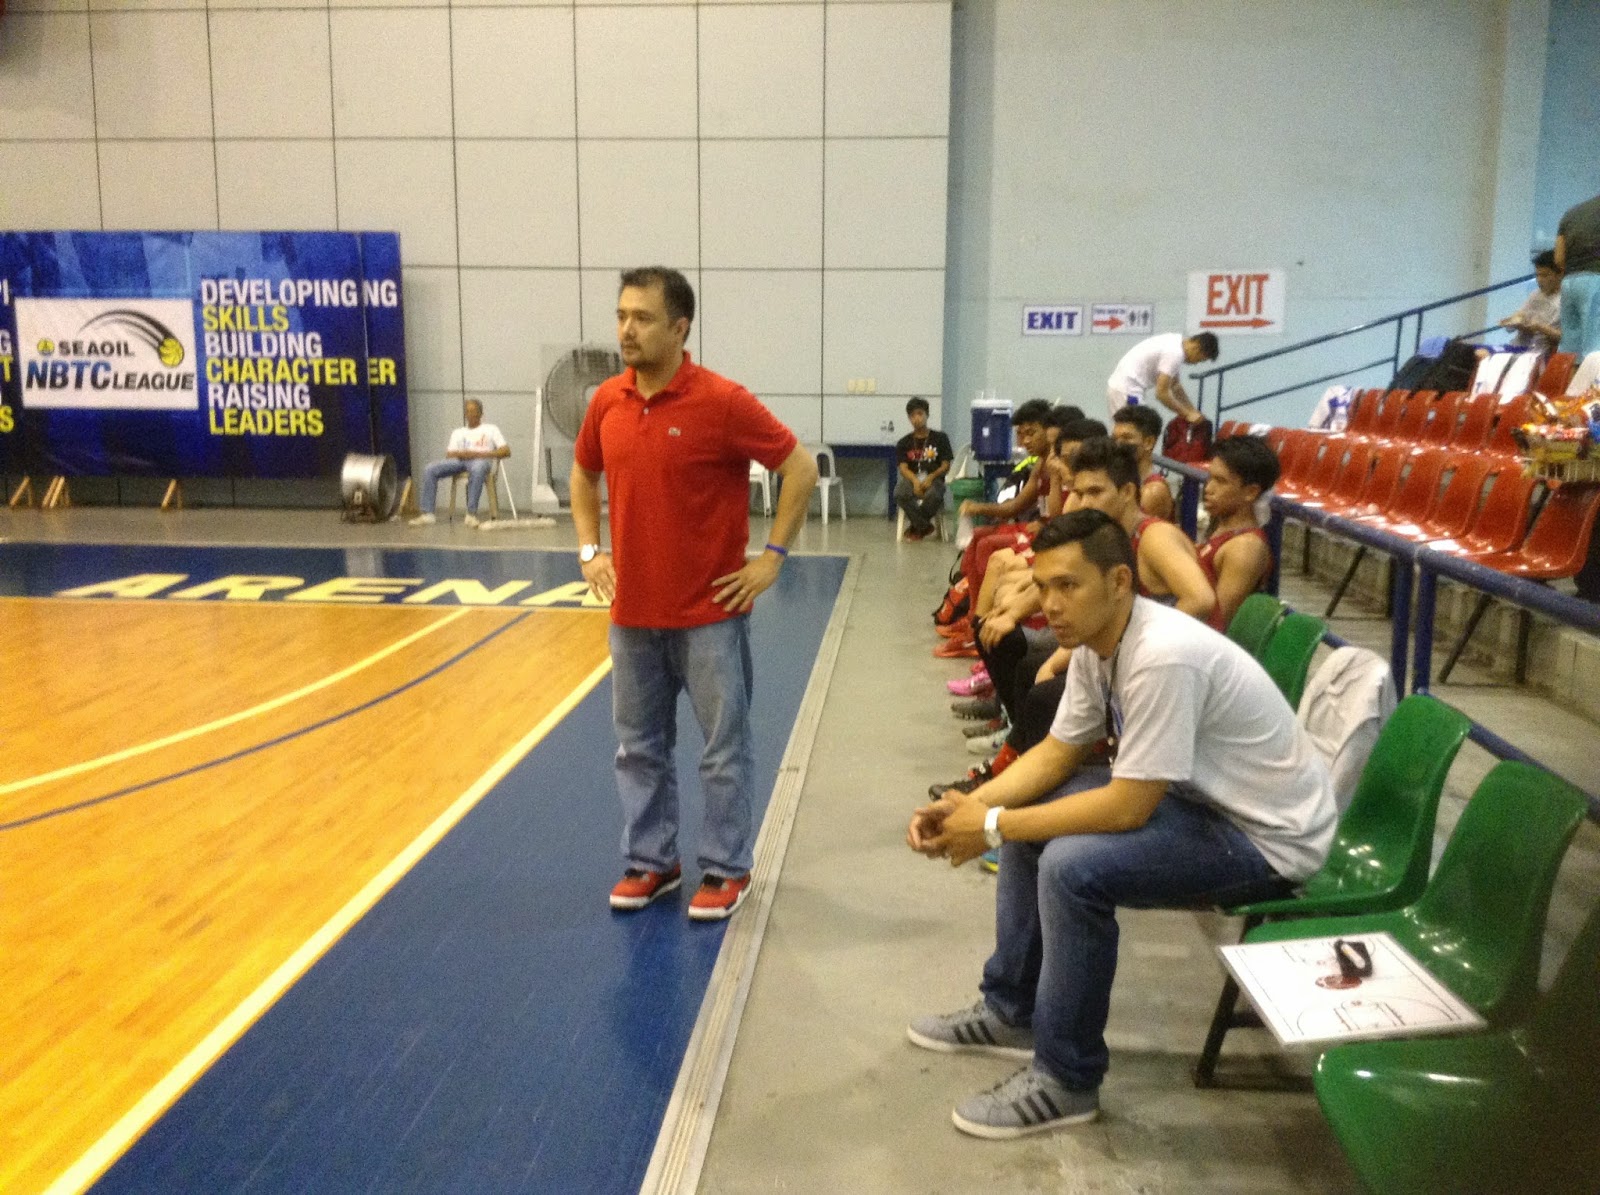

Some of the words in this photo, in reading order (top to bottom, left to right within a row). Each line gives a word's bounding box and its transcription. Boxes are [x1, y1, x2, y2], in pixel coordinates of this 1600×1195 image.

[201, 279, 358, 307] DEVELOPING
[1206, 274, 1269, 315] EXIT
[202, 305, 289, 332] SKILLS
[1027, 311, 1078, 330] EXIT
[58, 340, 135, 357] SEAOIL
[205, 331, 323, 358] BUILDING
[206, 357, 358, 385] CHARACTER
[208, 383, 311, 410] RAISING
[209, 408, 325, 436] LEADERS
[52, 573, 613, 607] ARENA
